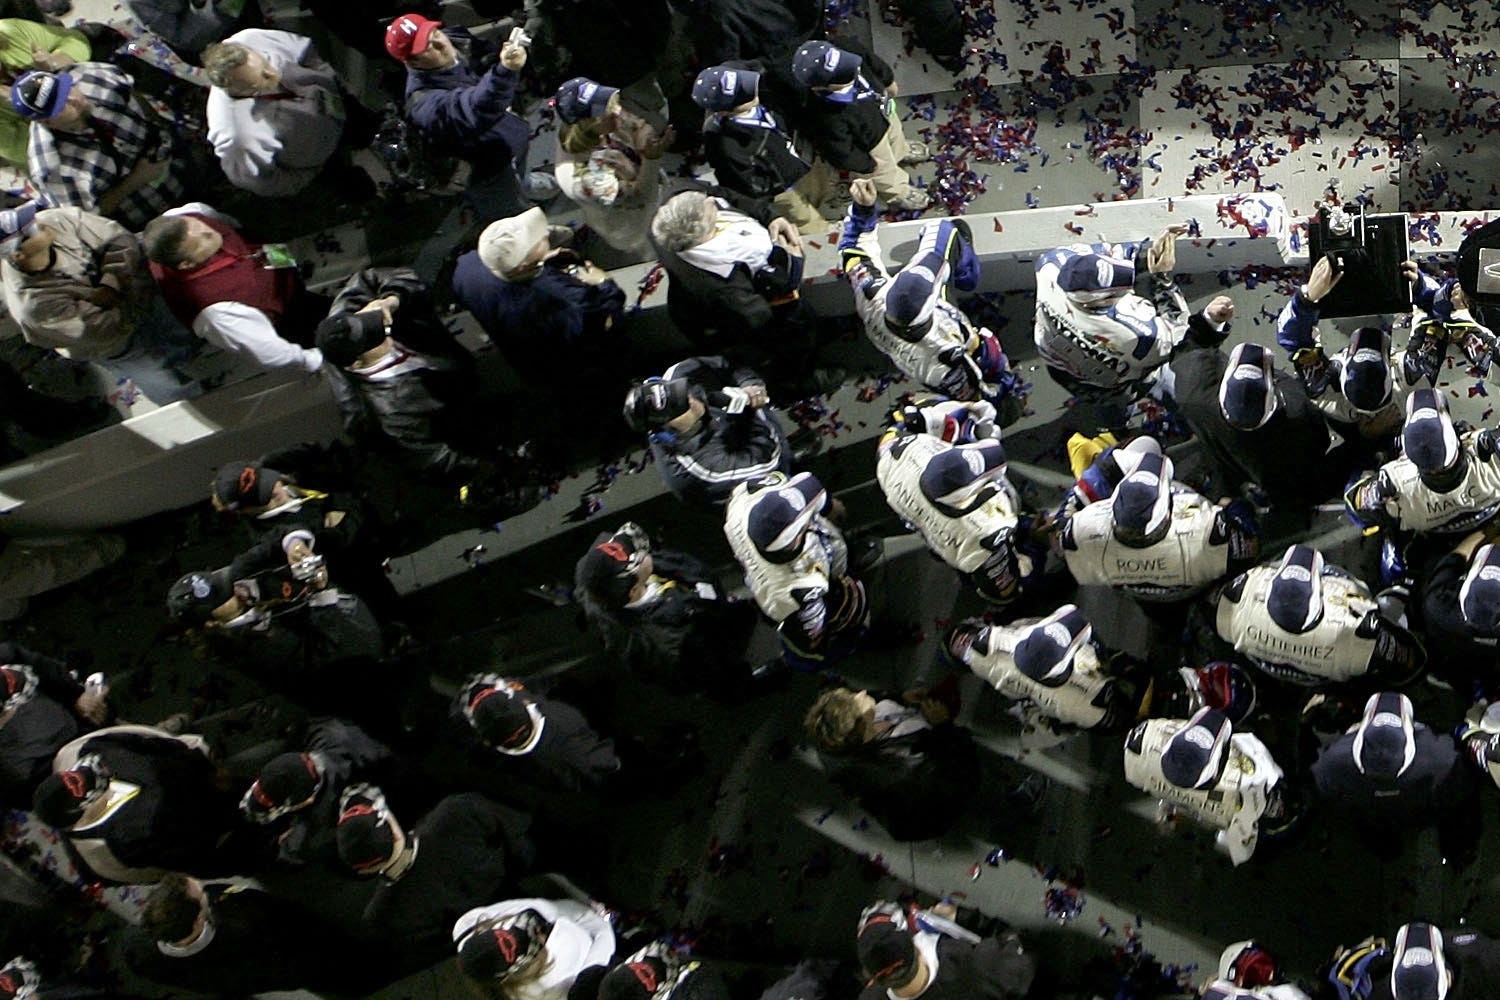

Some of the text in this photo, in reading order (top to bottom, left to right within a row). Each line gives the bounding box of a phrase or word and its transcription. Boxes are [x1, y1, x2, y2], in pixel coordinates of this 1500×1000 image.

[893, 481, 963, 550] ANDERSON
[1425, 484, 1480, 515] MALEC
[1116, 557, 1168, 573] ROWE
[1247, 624, 1335, 660] GUTIERREZ
